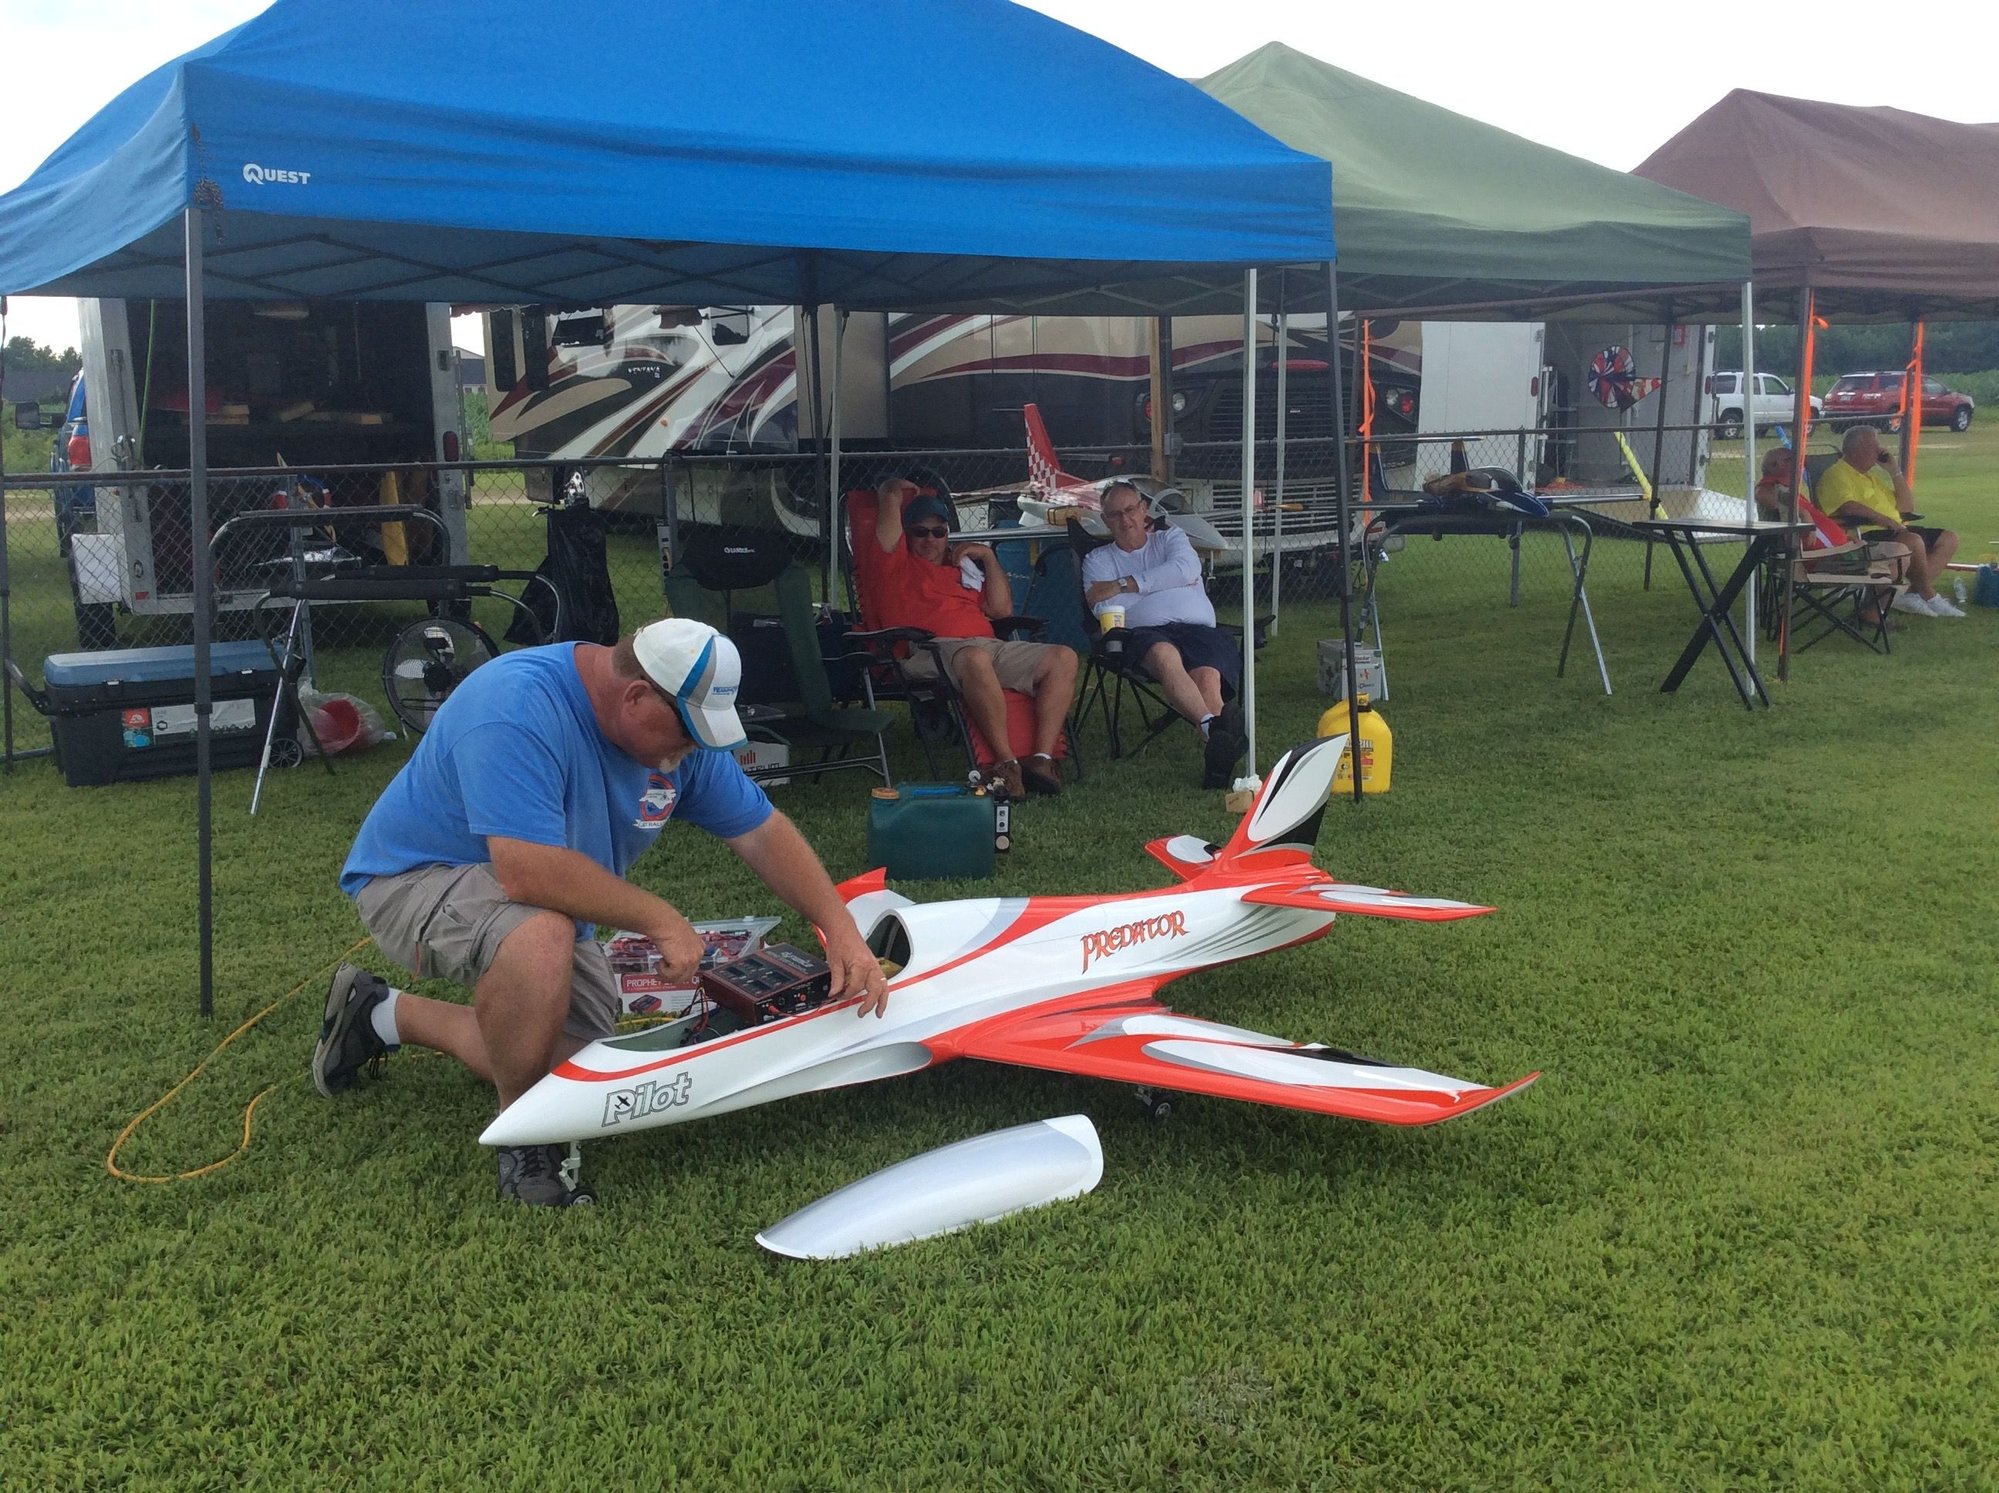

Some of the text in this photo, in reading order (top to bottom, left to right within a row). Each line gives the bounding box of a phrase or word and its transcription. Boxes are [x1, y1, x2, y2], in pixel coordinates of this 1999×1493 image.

[242, 163, 311, 185] QUEST
[1080, 910, 1190, 975] PREDATOR
[601, 1071, 692, 1128] Pilot
